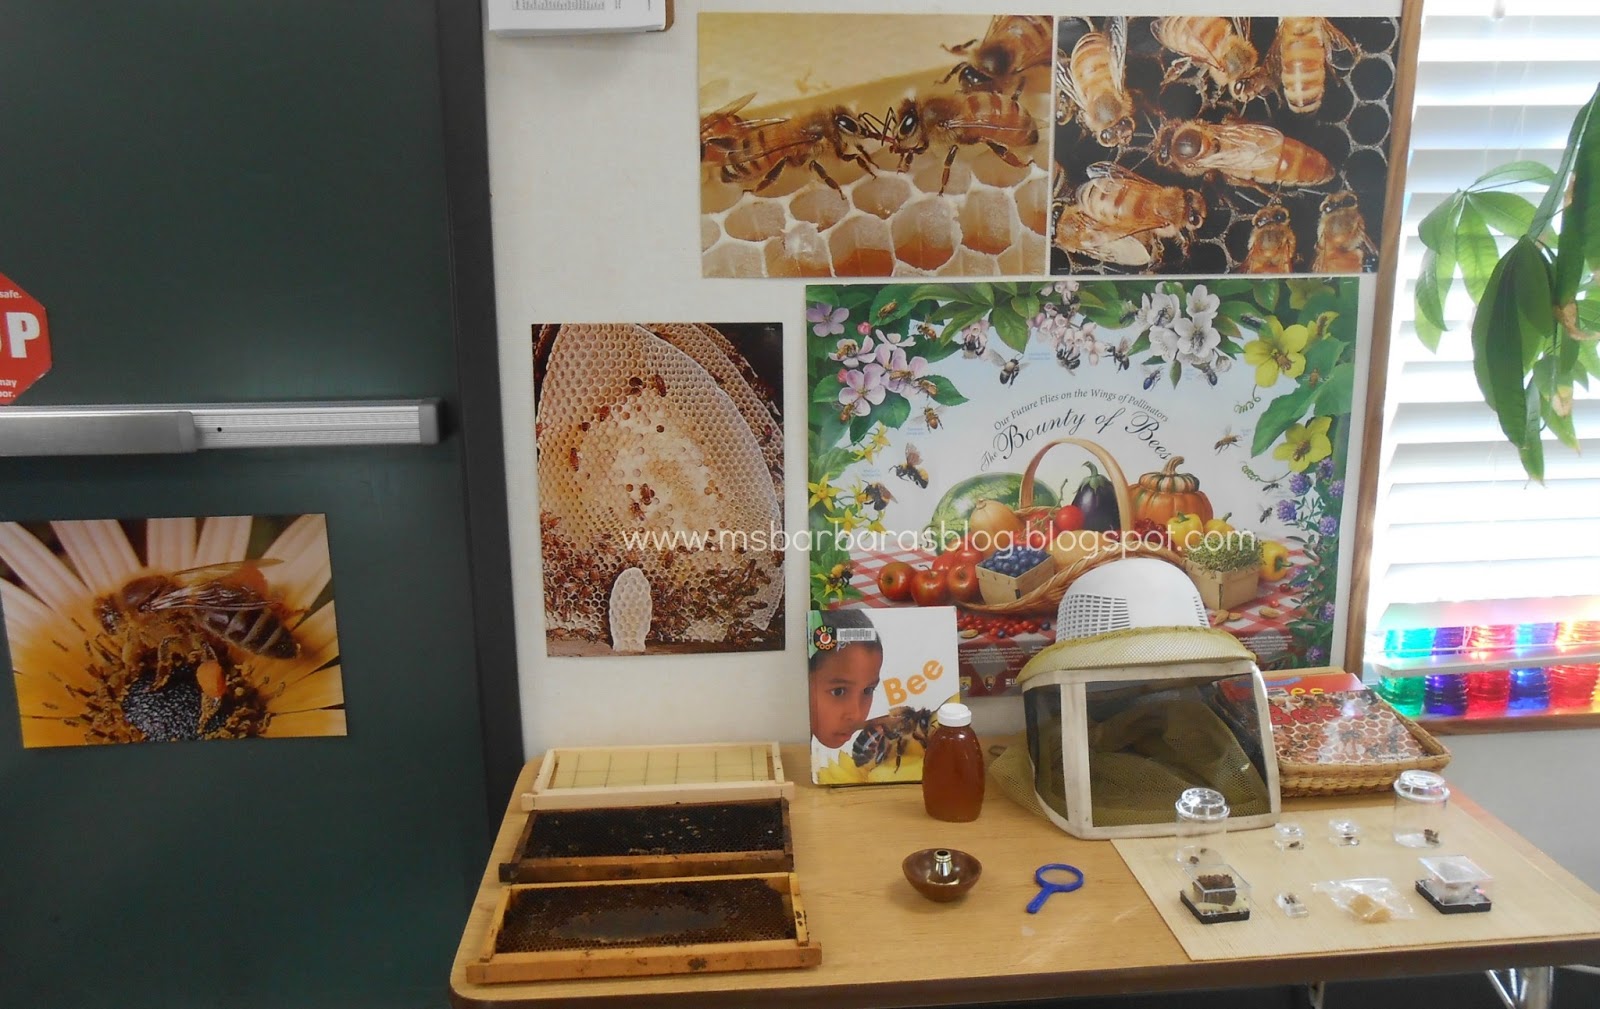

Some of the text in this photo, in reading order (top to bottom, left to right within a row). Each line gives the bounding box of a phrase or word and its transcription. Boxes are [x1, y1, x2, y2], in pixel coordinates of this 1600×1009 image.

[0, 312, 41, 358] P
[994, 389, 1169, 431] Our Future Flies on the Wings of Pollinators
[980, 407, 1171, 472] The Bounty of Bees
[816, 626, 833, 636] BUG
[883, 660, 943, 706] Bee
